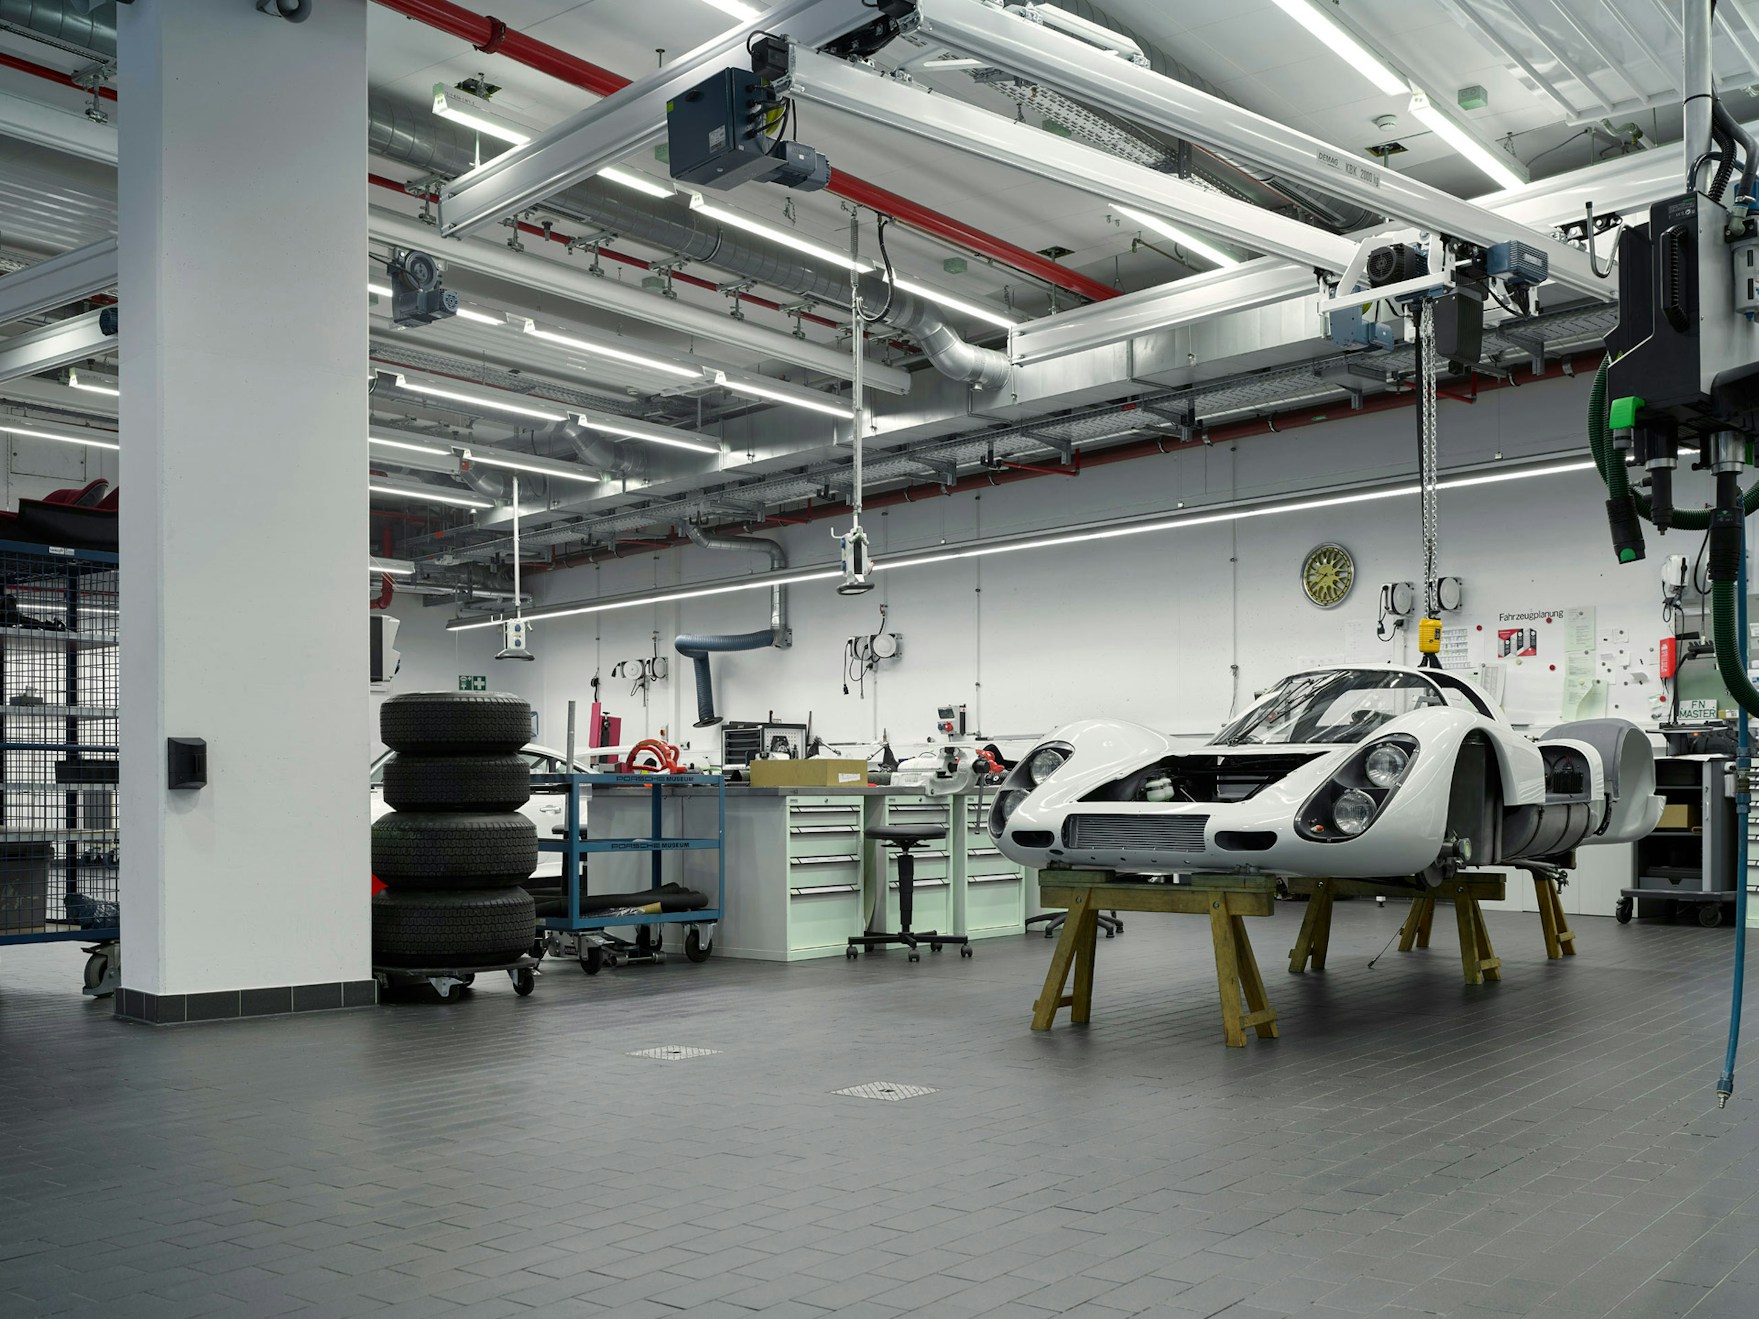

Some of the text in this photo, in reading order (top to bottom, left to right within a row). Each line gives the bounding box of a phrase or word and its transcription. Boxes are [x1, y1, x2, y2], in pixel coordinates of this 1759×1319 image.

[1319, 152, 1339, 166] DEMAG
[1345, 162, 1357, 177] KBK
[1360, 169, 1372, 183] 2000
[1499, 610, 1564, 622] Fahrzeugplanung
[1679, 709, 1716, 718] MASTER
